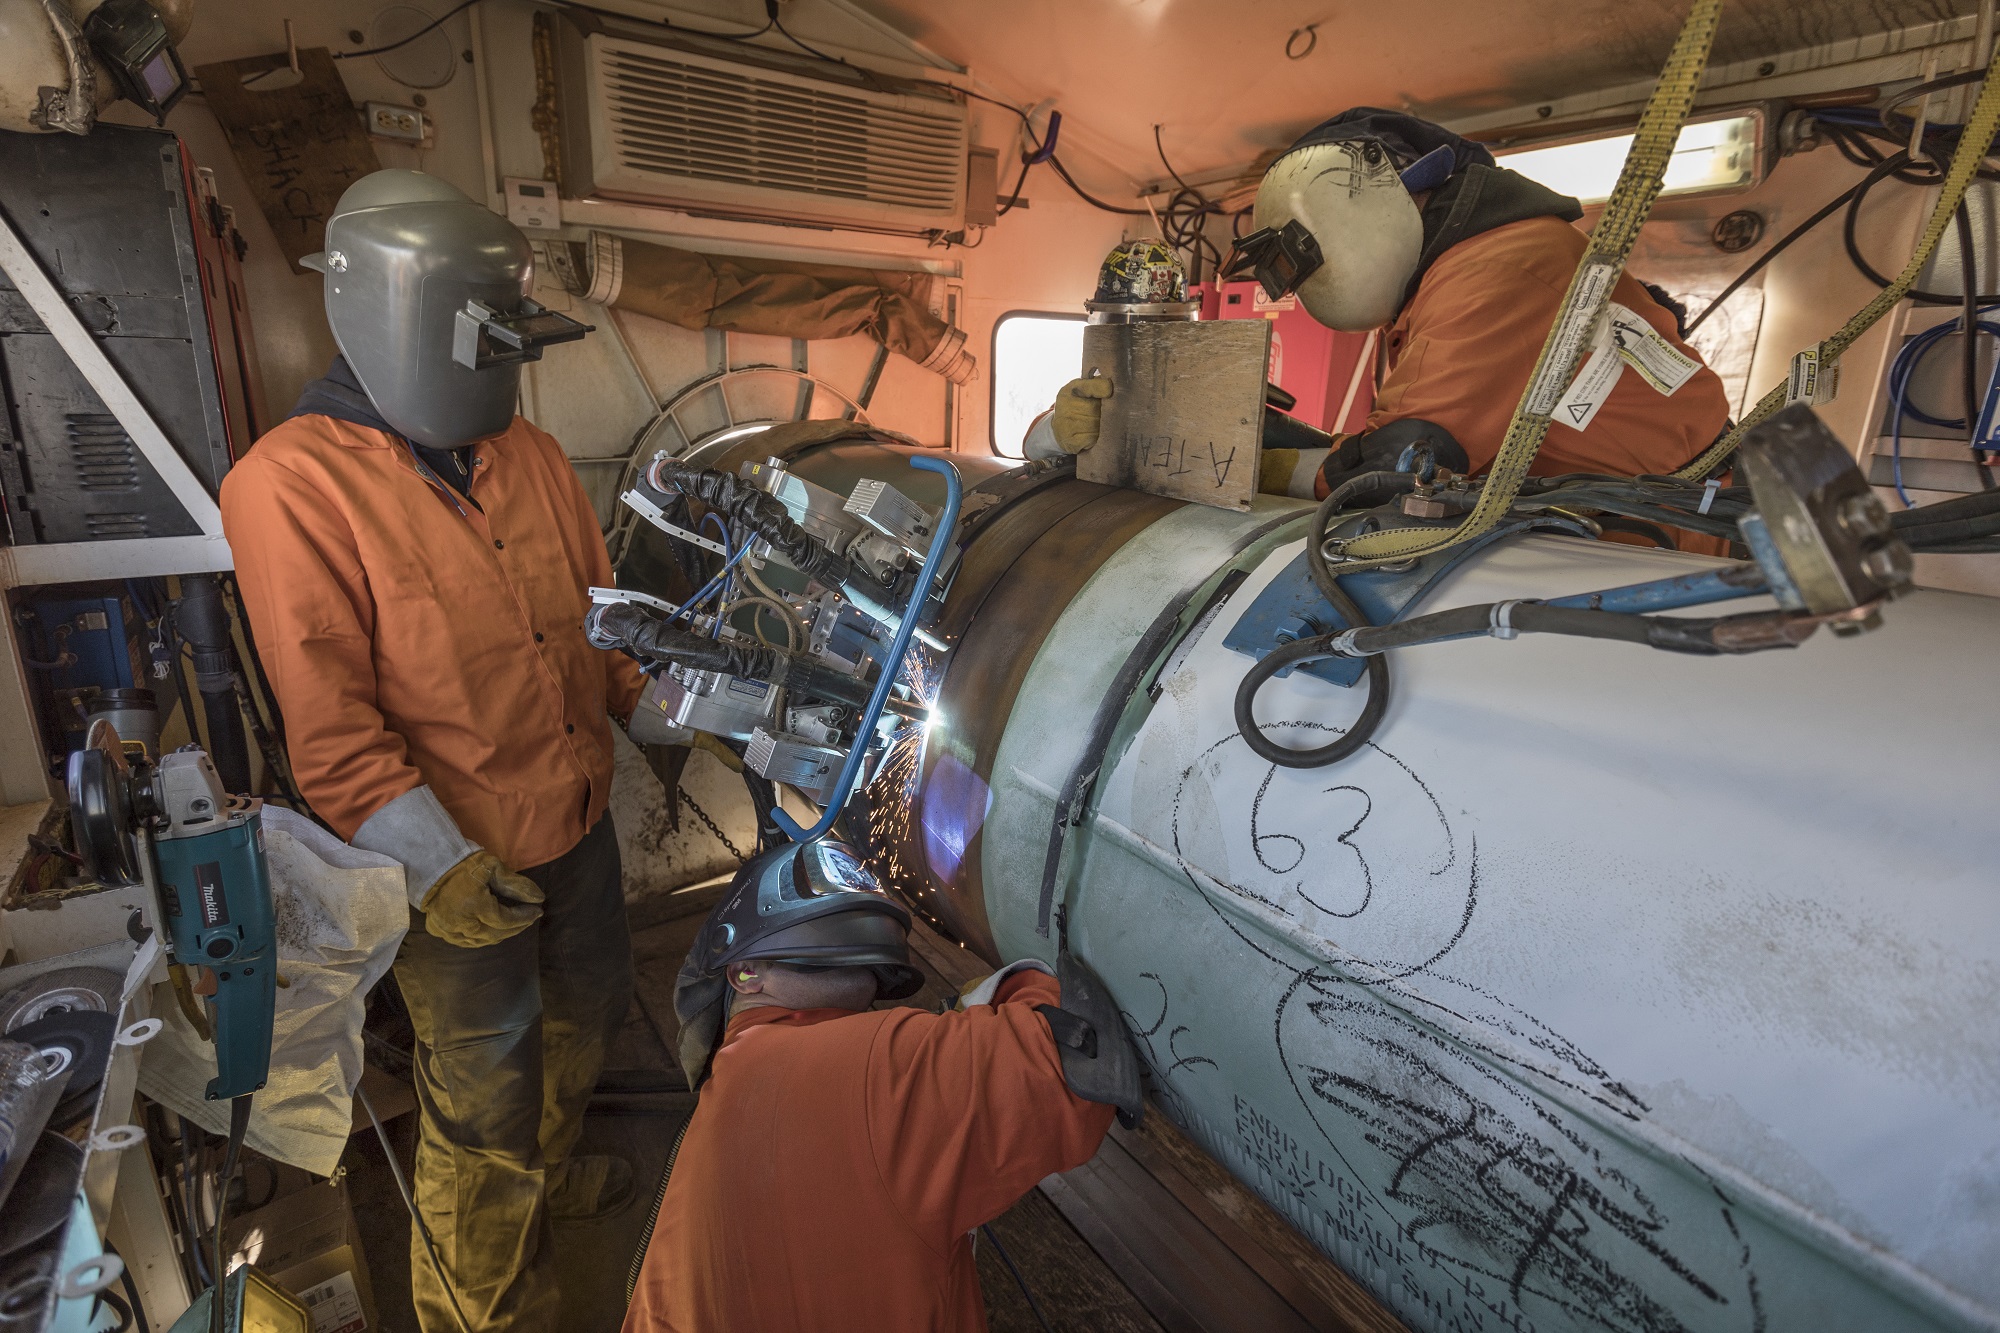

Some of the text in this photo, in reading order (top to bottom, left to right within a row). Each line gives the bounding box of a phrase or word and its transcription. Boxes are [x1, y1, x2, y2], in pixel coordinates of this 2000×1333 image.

[249, 129, 323, 233] SHACK
[1654, 338, 1693, 369] WARNING
[1252, 763, 1372, 917] 63
[201, 883, 219, 923] Makita
[1234, 1094, 1374, 1220] ENBRIDGE
[1236, 1117, 1318, 1198] EVRAZ
[1339, 1201, 1413, 1277] MADE
[1447, 1288, 1483, 1331] IN
